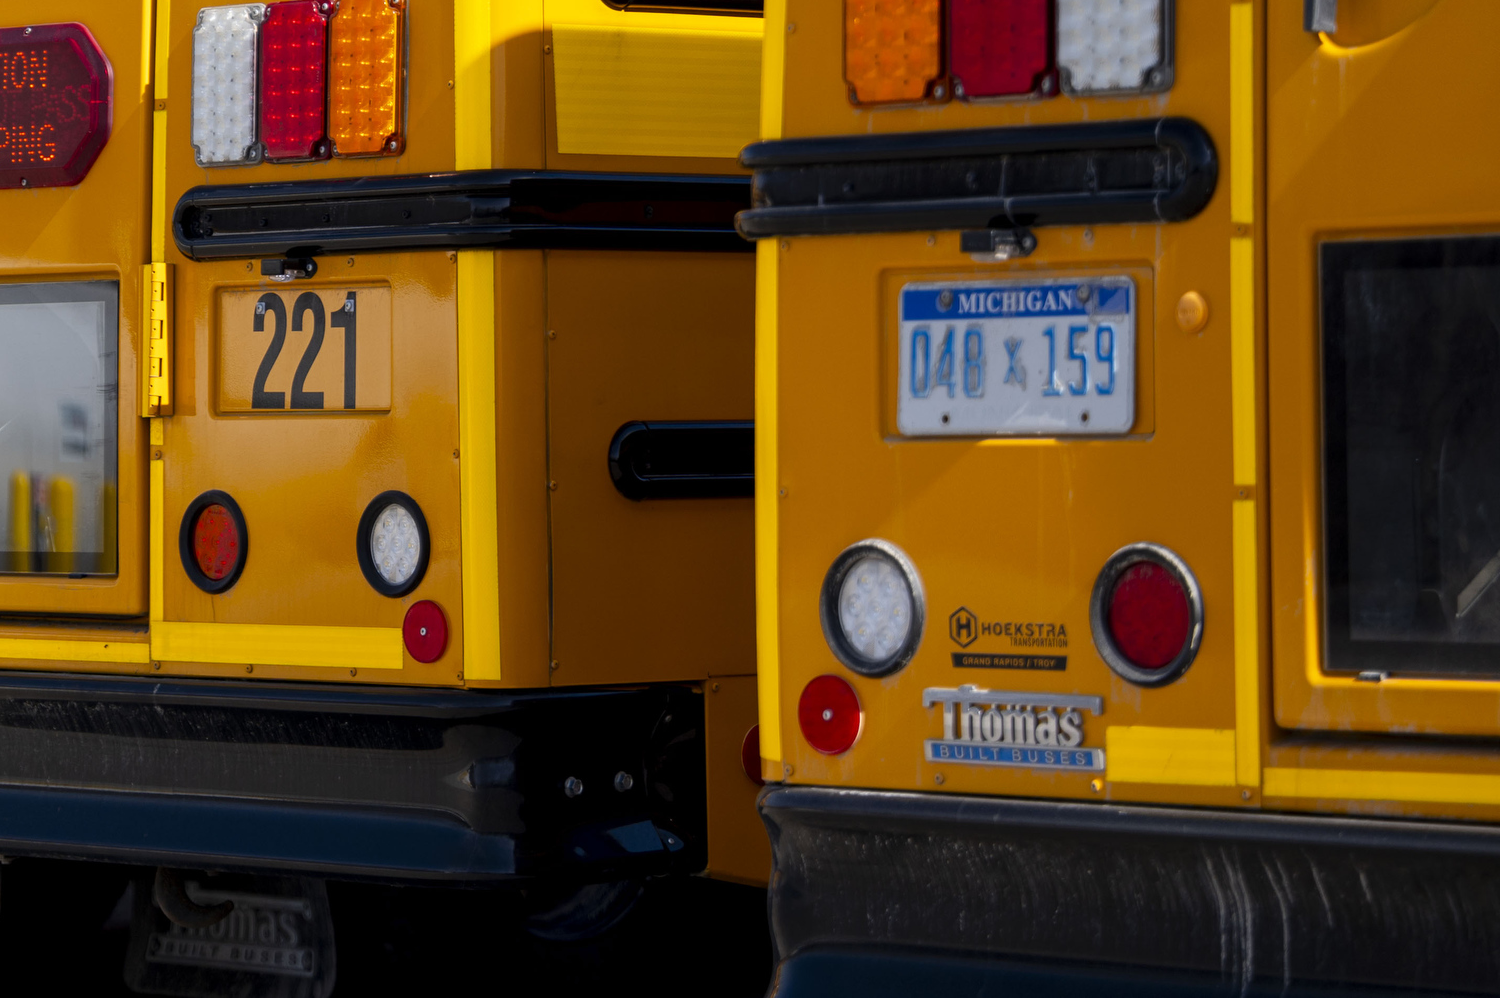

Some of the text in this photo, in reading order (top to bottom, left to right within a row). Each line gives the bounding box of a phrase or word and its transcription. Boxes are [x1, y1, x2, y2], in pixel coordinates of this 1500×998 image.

[957, 289, 1074, 314] MICHIGAN
[251, 291, 356, 409] 221
[910, 324, 984, 398] 048
[1041, 323, 1118, 397] 159
[981, 621, 1067, 638] HOEKSTRA
[1010, 636, 1068, 648] TRANSPORTATION
[962, 656, 991, 666] GRAND
[993, 657, 1024, 667] RAPIDS
[1033, 658, 1056, 668] TROY
[923, 687, 1103, 748] Thomas
[939, 745, 1086, 765] BUILT BUSES
